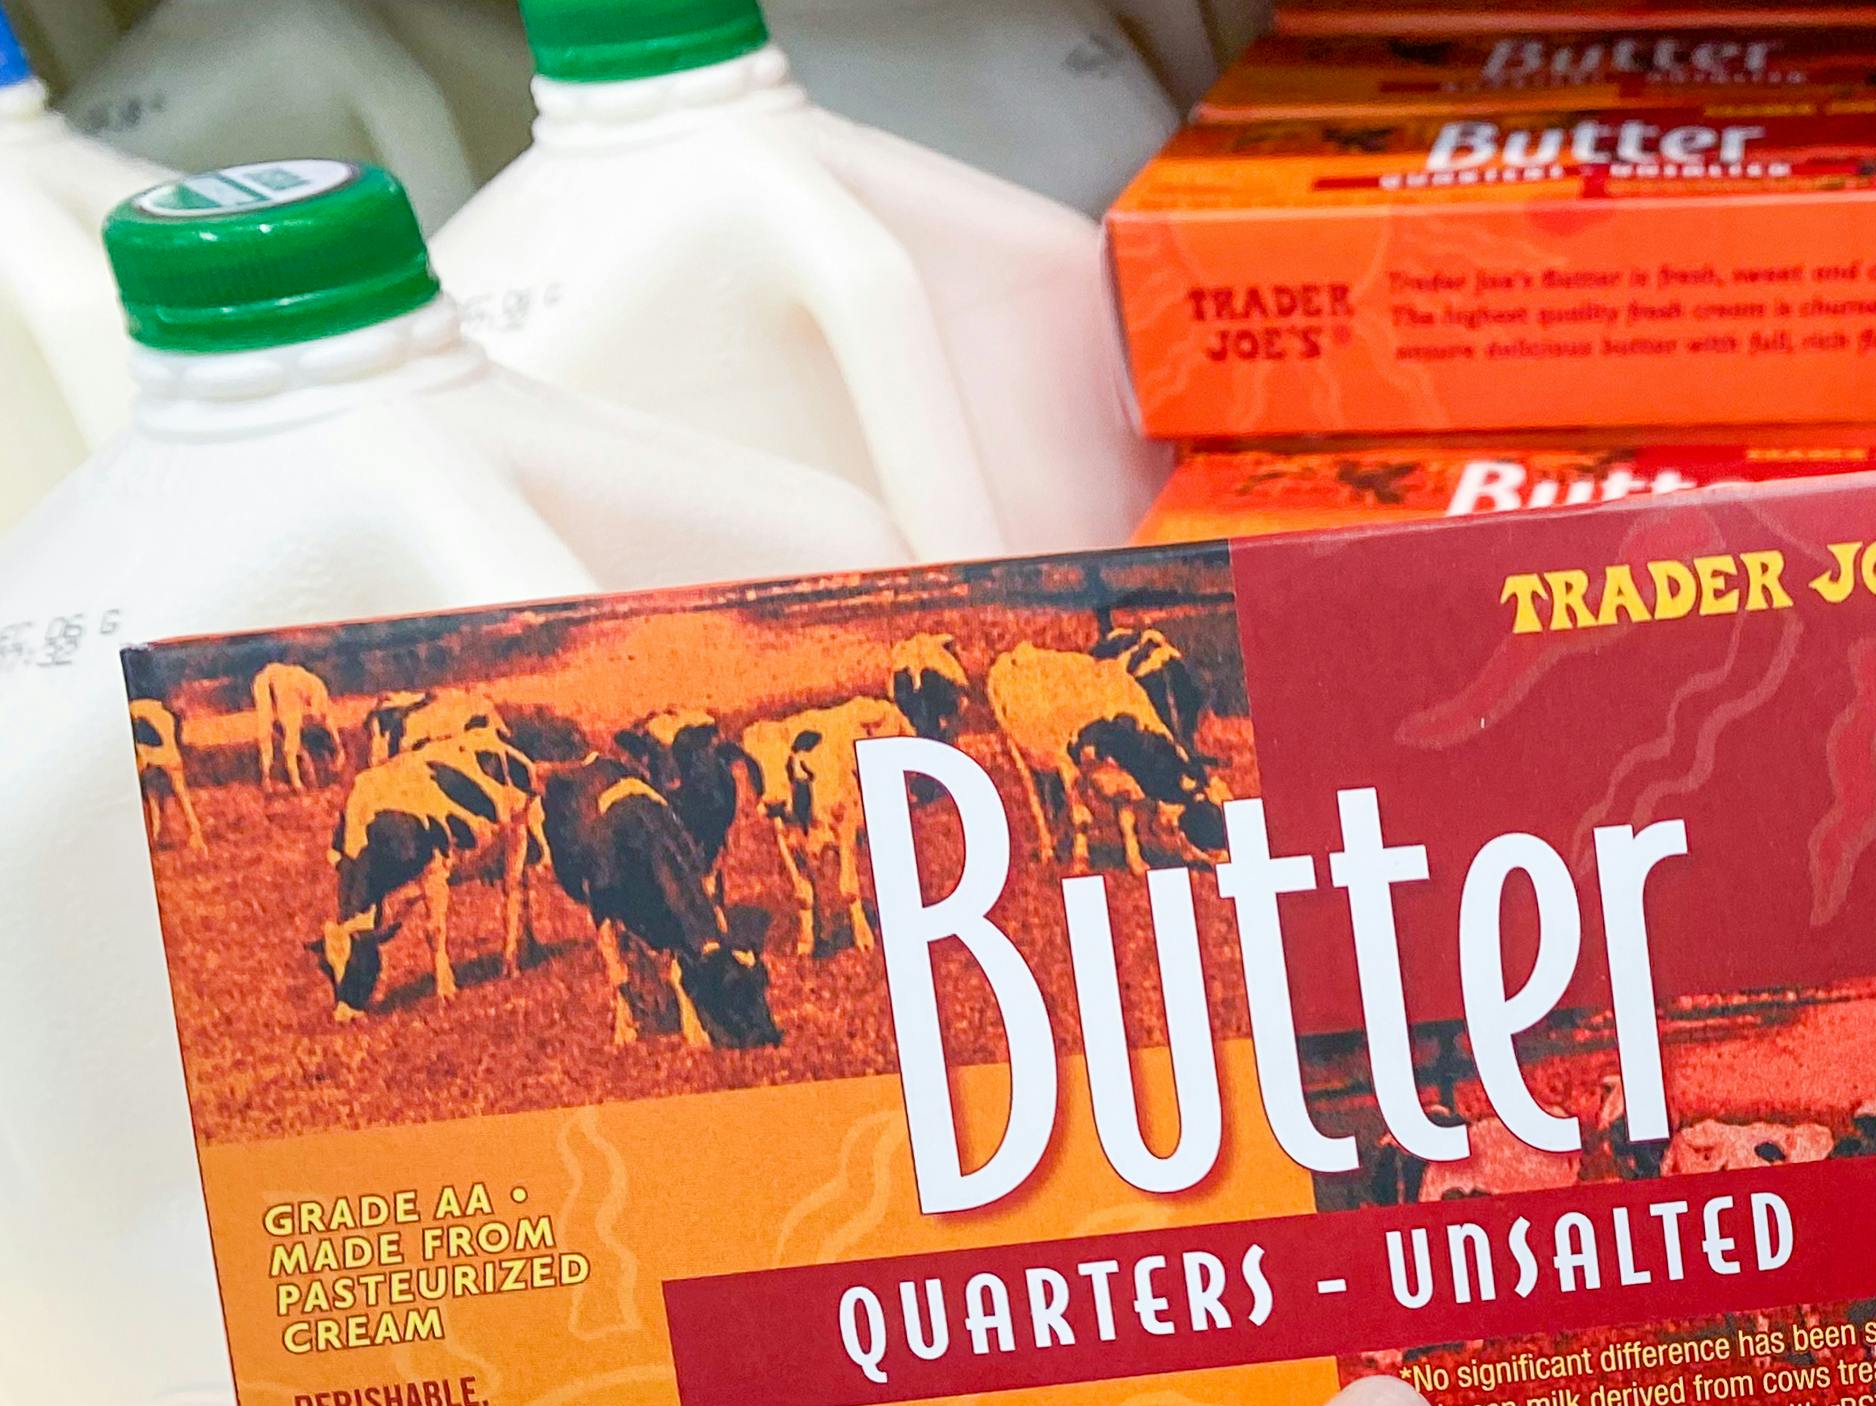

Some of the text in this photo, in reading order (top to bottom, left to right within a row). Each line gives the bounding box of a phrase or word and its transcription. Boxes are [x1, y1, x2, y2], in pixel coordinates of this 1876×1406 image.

[1426, 120, 1766, 171] Butter
[1187, 285, 1354, 322] TRADER
[1501, 549, 1790, 634] TRADER
[853, 733, 1692, 1217] Butter
[263, 1182, 492, 1238] GRADE AA
[269, 1216, 555, 1278] MADE FROM
[276, 1253, 590, 1316] PASTEURIZED
[839, 1244, 1274, 1385] QUARTERS
[1385, 1191, 1794, 1312] UNSALTED
[282, 1307, 445, 1355] CREAM
[1456, 1347, 1592, 1391] significant
[1599, 1333, 1731, 1376] difference
[1736, 1327, 1787, 1363] has
[1792, 1319, 1857, 1354] been
[1692, 1369, 1755, 1403] from
[1761, 1365, 1832, 1397] cows
